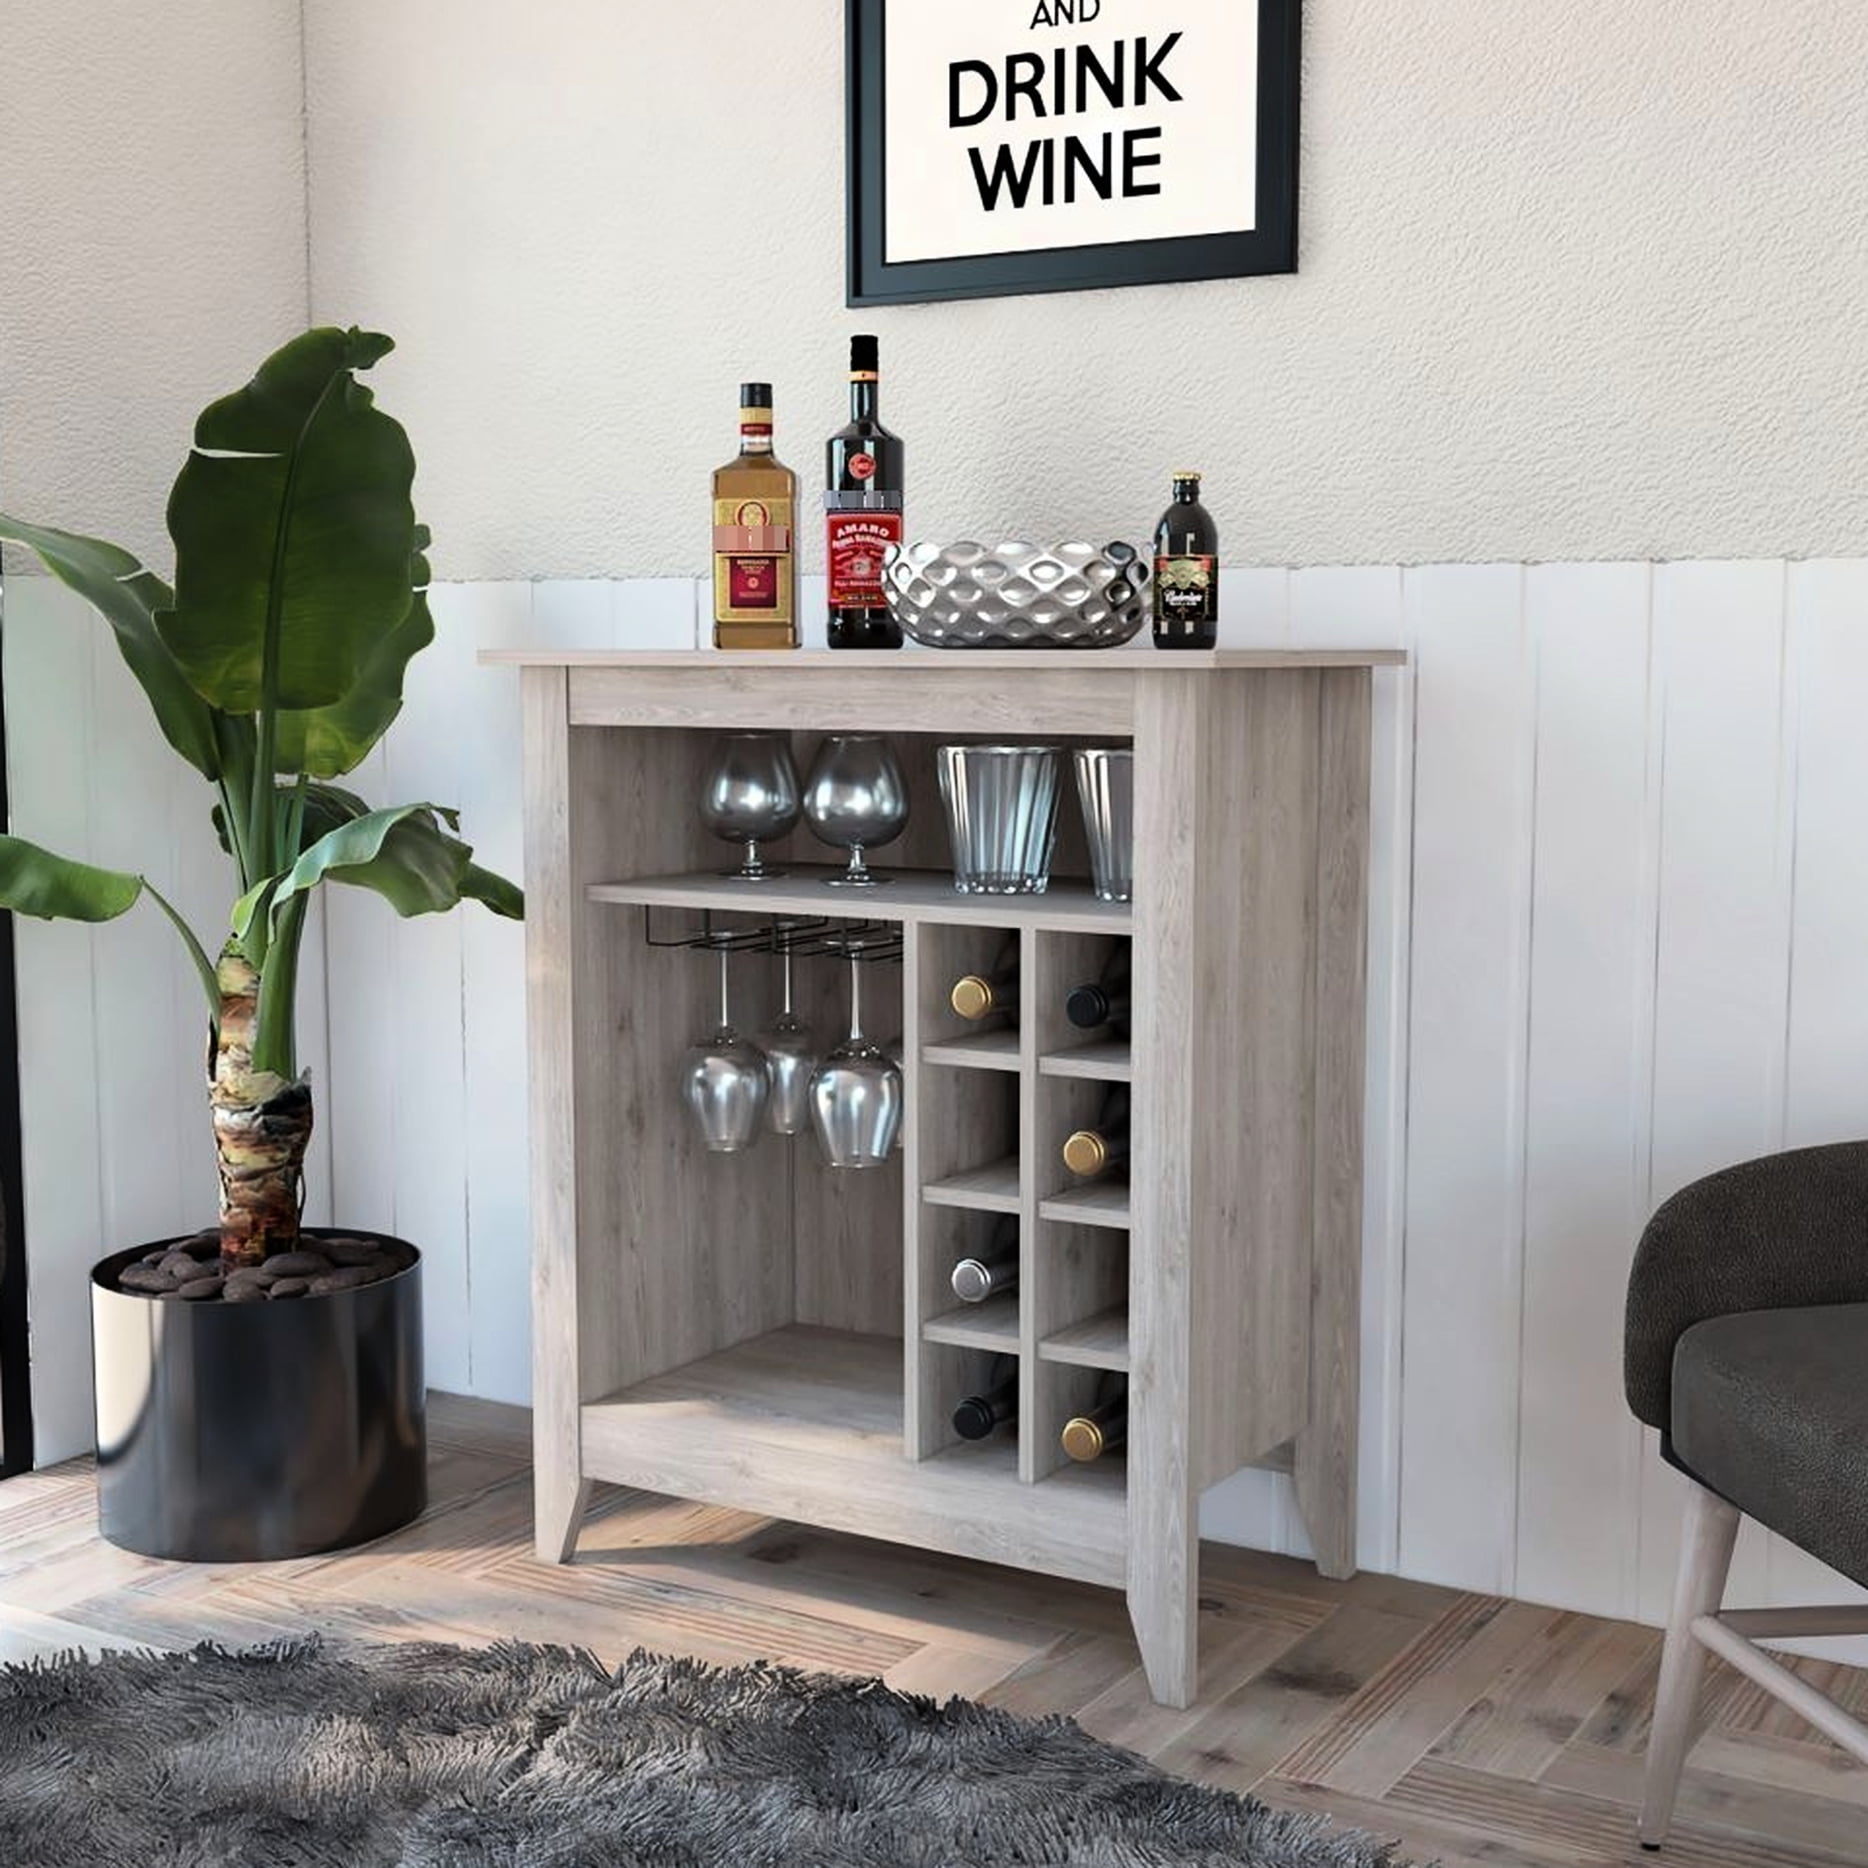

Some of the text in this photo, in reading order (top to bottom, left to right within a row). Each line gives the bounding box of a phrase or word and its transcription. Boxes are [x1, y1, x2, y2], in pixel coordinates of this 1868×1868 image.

[1030, 0, 1101, 29] AND
[949, 32, 1183, 128] DRINK
[968, 127, 1162, 211] WINE
[837, 523, 890, 538] AMARO
